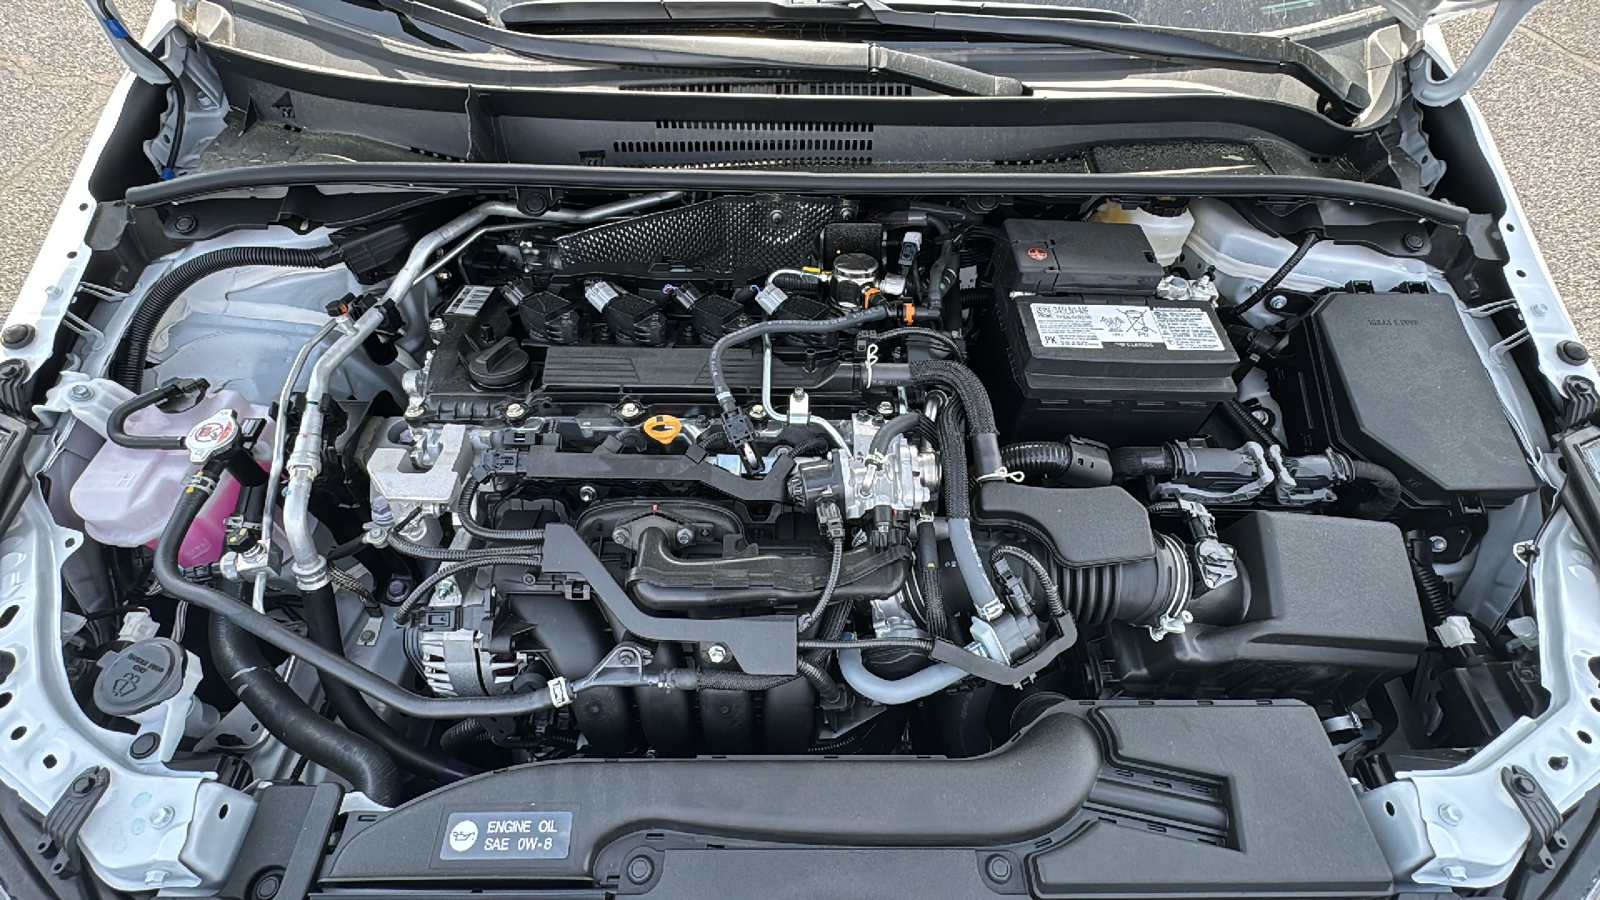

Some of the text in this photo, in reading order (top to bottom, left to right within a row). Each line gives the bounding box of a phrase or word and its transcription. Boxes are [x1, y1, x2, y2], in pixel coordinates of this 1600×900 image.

[1044, 335, 1058, 344] PK
[487, 820, 558, 834] ENGINE OIL
[484, 837, 553, 851] SAE 0W-8
